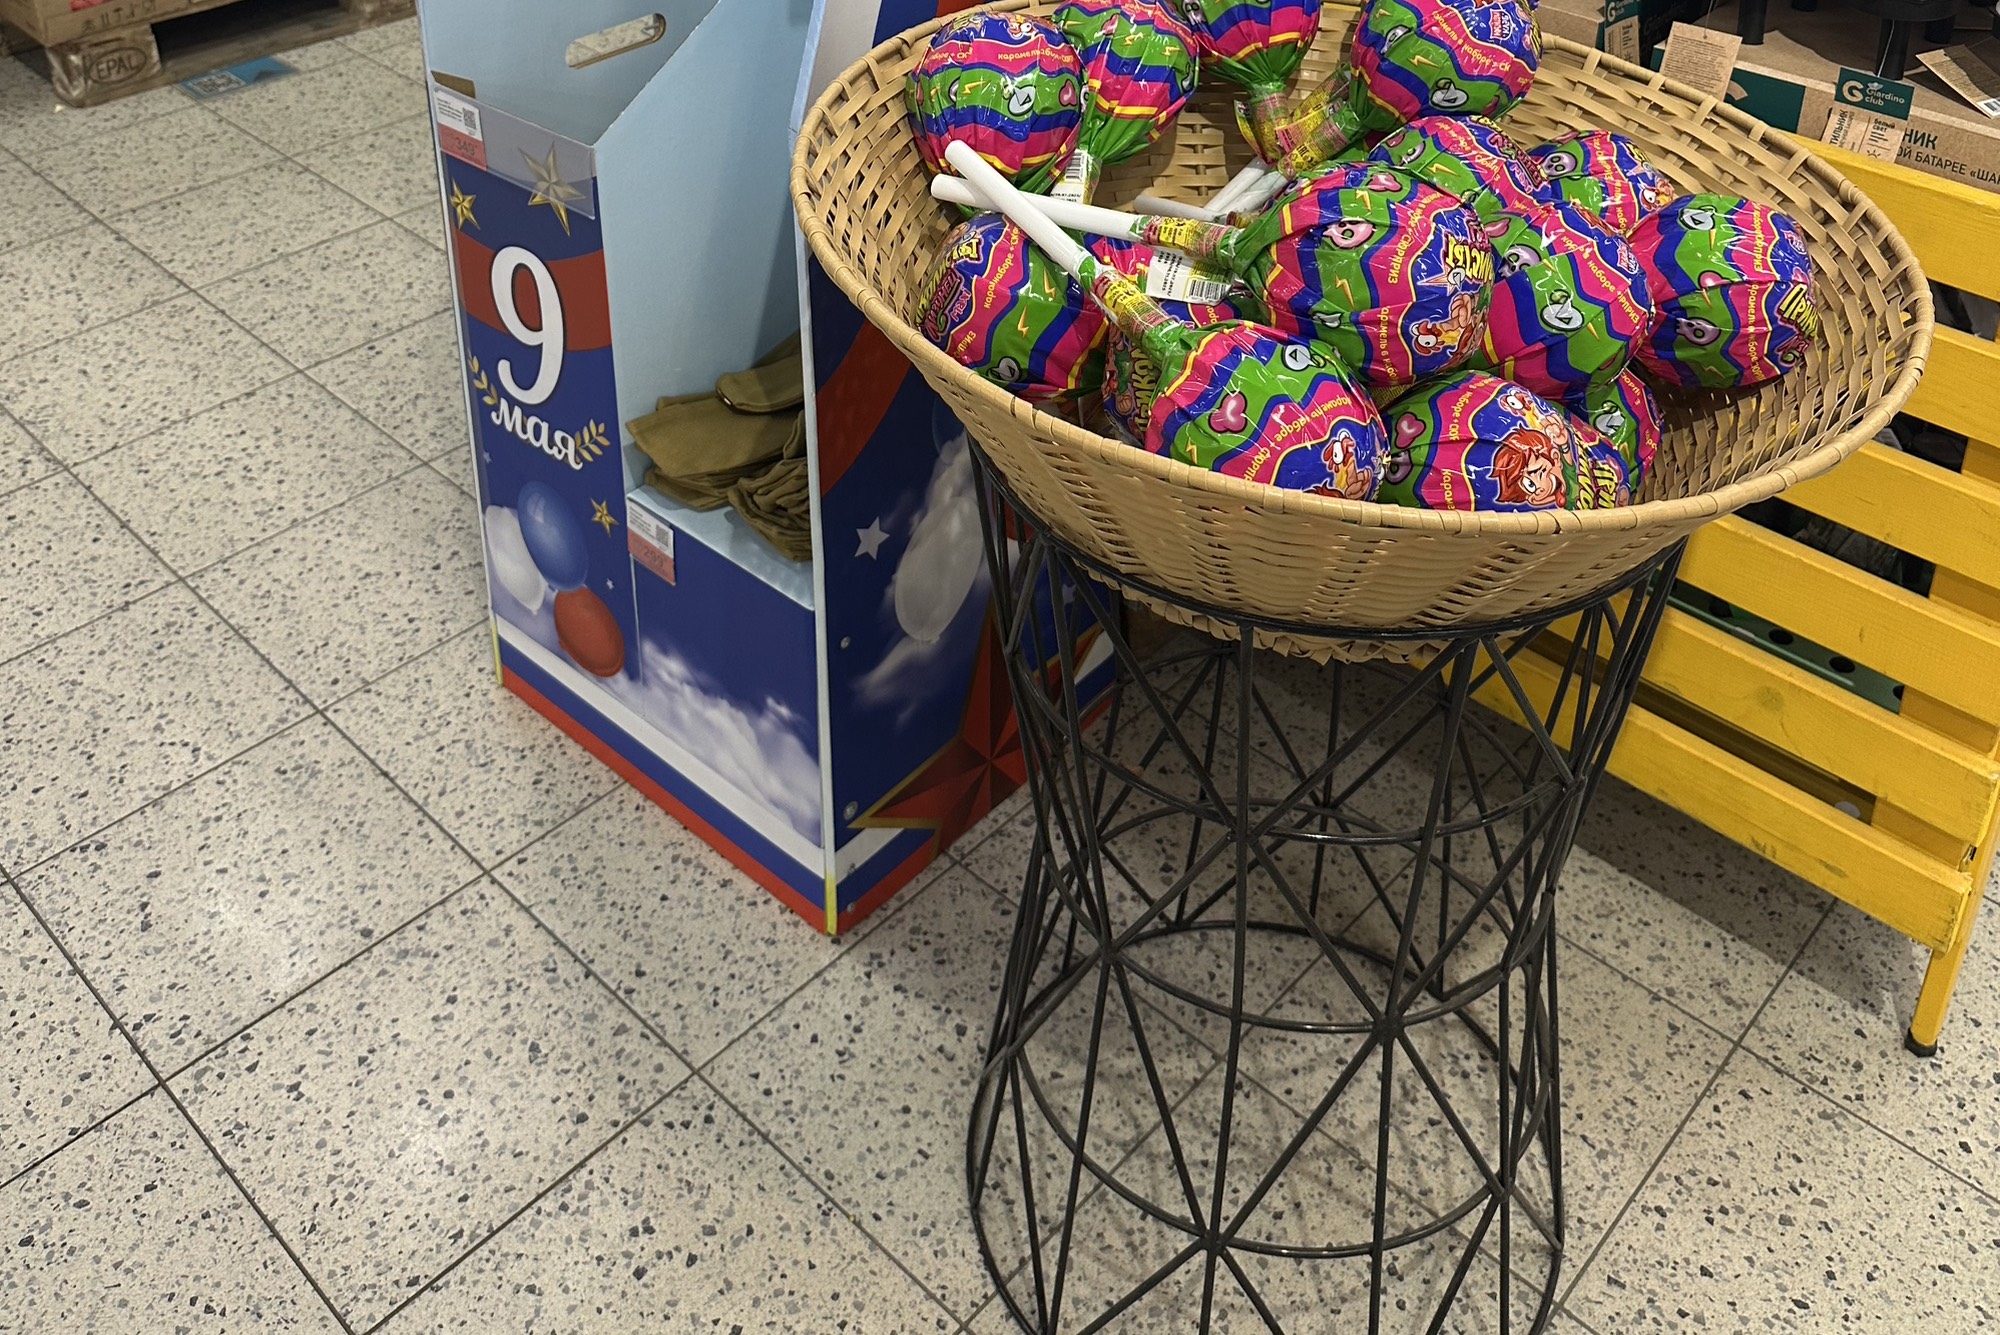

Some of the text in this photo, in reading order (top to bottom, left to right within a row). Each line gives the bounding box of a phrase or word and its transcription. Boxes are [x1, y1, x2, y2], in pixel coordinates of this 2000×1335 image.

[95, 54, 138, 81] EPAL
[1864, 96, 1884, 106] club
[1866, 87, 1905, 105] Giardino
[1915, 151, 1967, 176] БАТАРЕЕ
[1587, 260, 1615, 292] наборе
[491, 246, 565, 406] 9
[490, 397, 584, 471] мая
